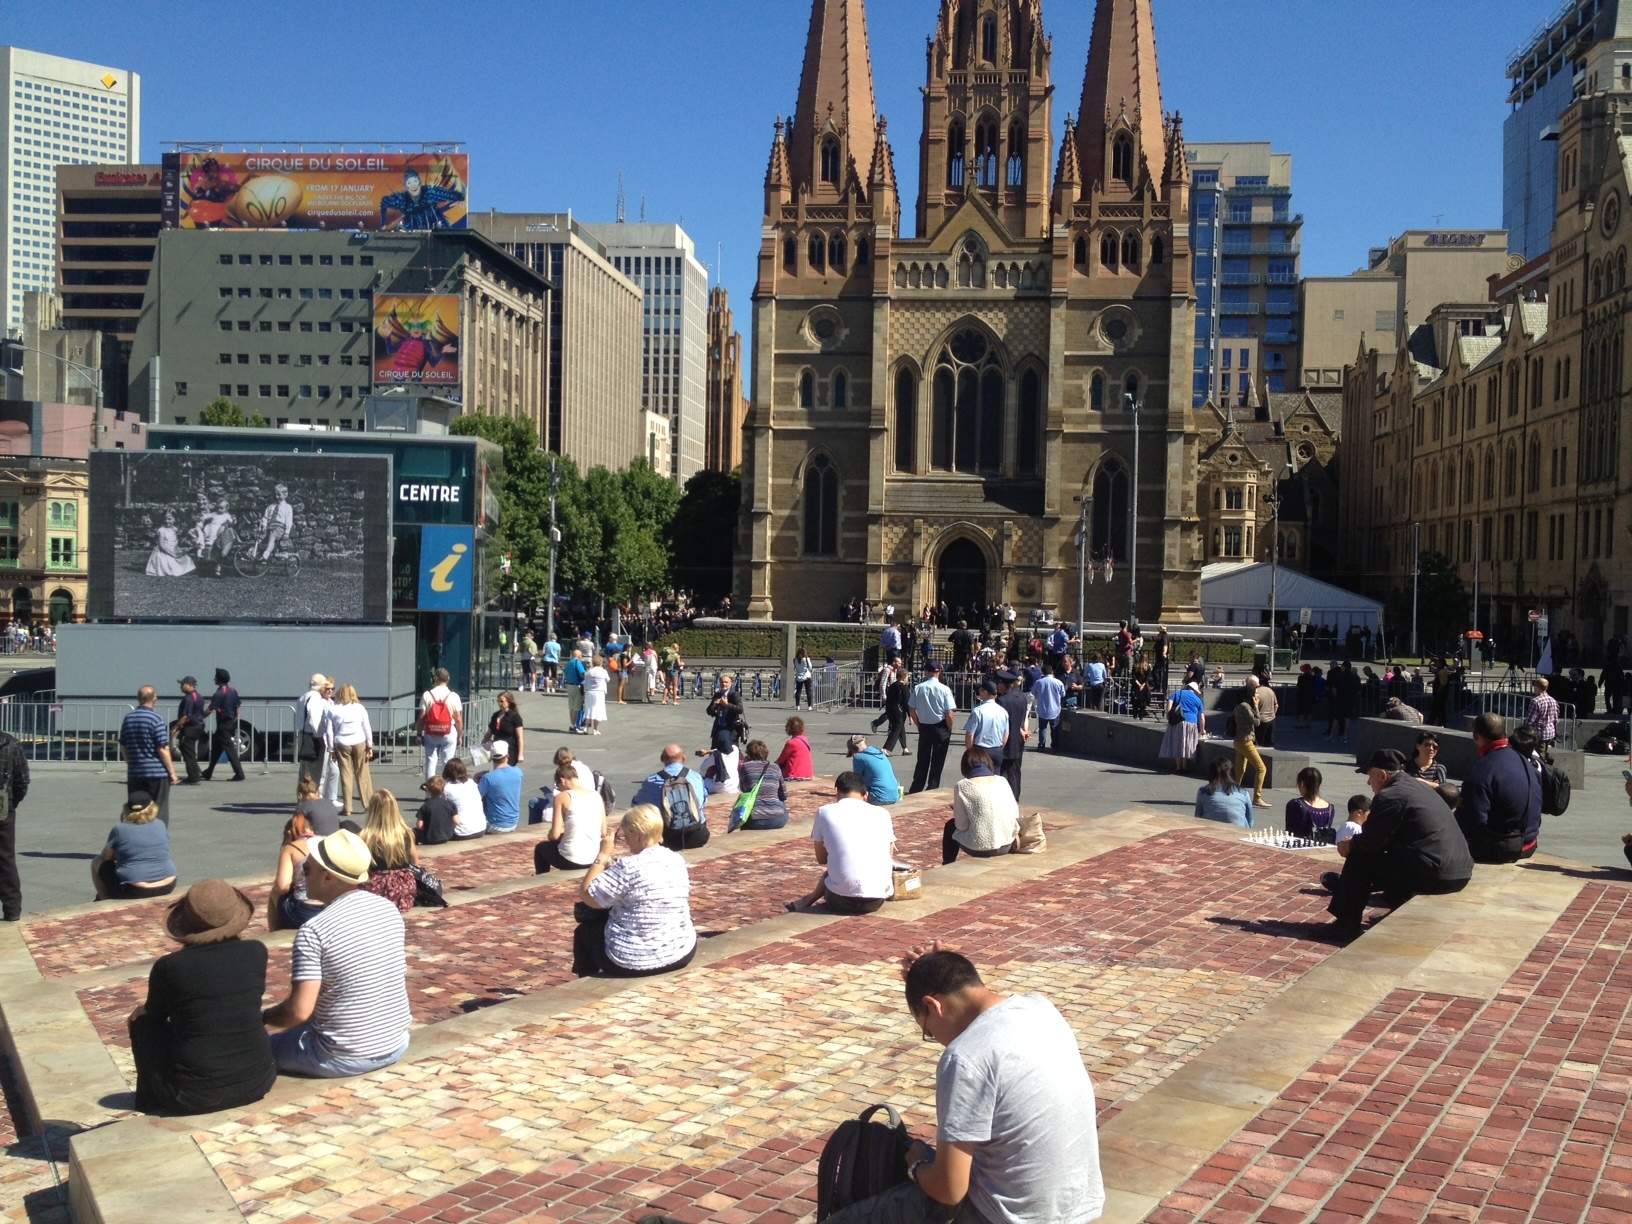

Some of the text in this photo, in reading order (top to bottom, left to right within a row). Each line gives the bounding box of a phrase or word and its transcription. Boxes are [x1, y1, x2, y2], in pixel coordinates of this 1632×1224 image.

[245, 158, 304, 173] CIRQUE
[309, 158, 331, 171] DU
[306, 184, 328, 193] FROM
[340, 184, 375, 193] JANUARY
[306, 208, 374, 218] cirquedusoleil.com
[379, 370, 409, 379] CIRQUE
[412, 370, 423, 378] DU
[400, 484, 460, 502] CENTRE
